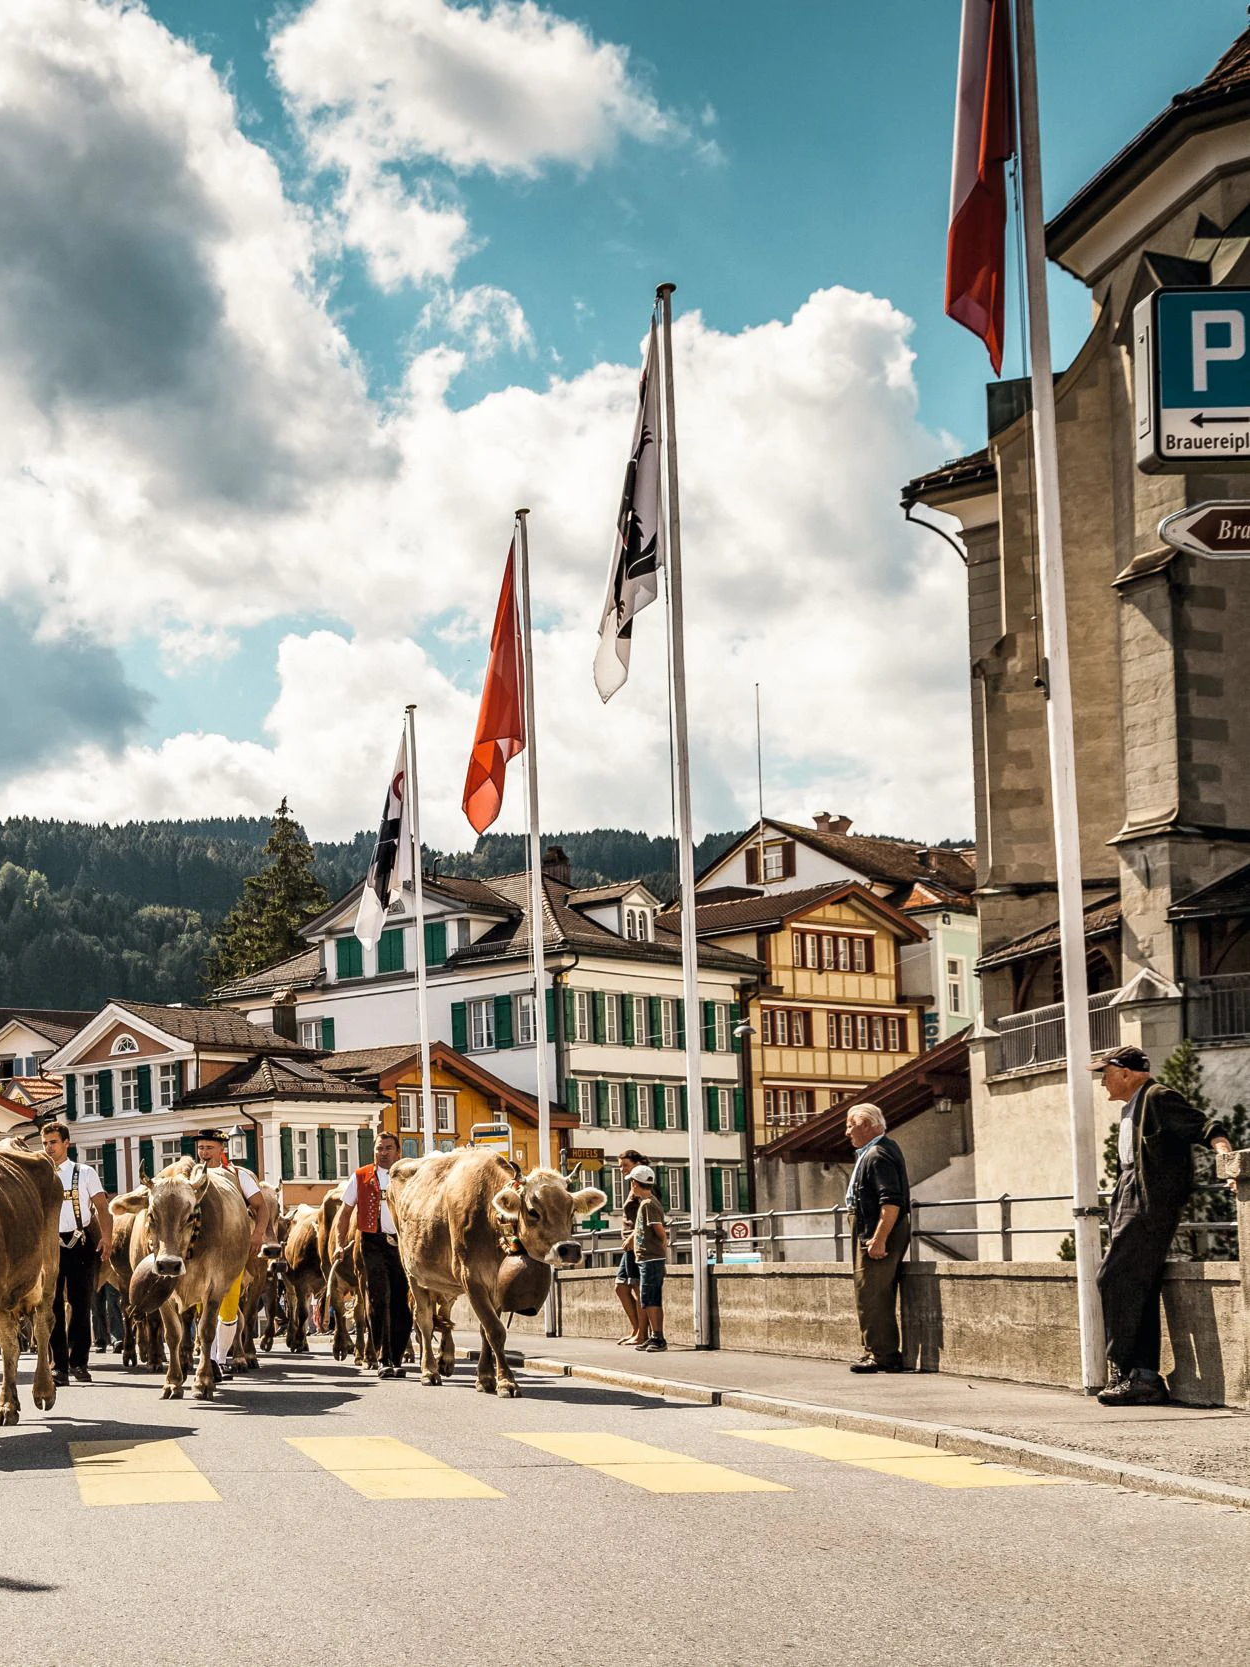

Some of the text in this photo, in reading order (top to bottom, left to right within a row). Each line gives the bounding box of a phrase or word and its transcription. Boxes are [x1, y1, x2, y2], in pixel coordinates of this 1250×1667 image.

[1191, 310, 1246, 392] P
[1166, 431, 1250, 453] Brauereipl
[572, 1149, 598, 1158] HOTELS
